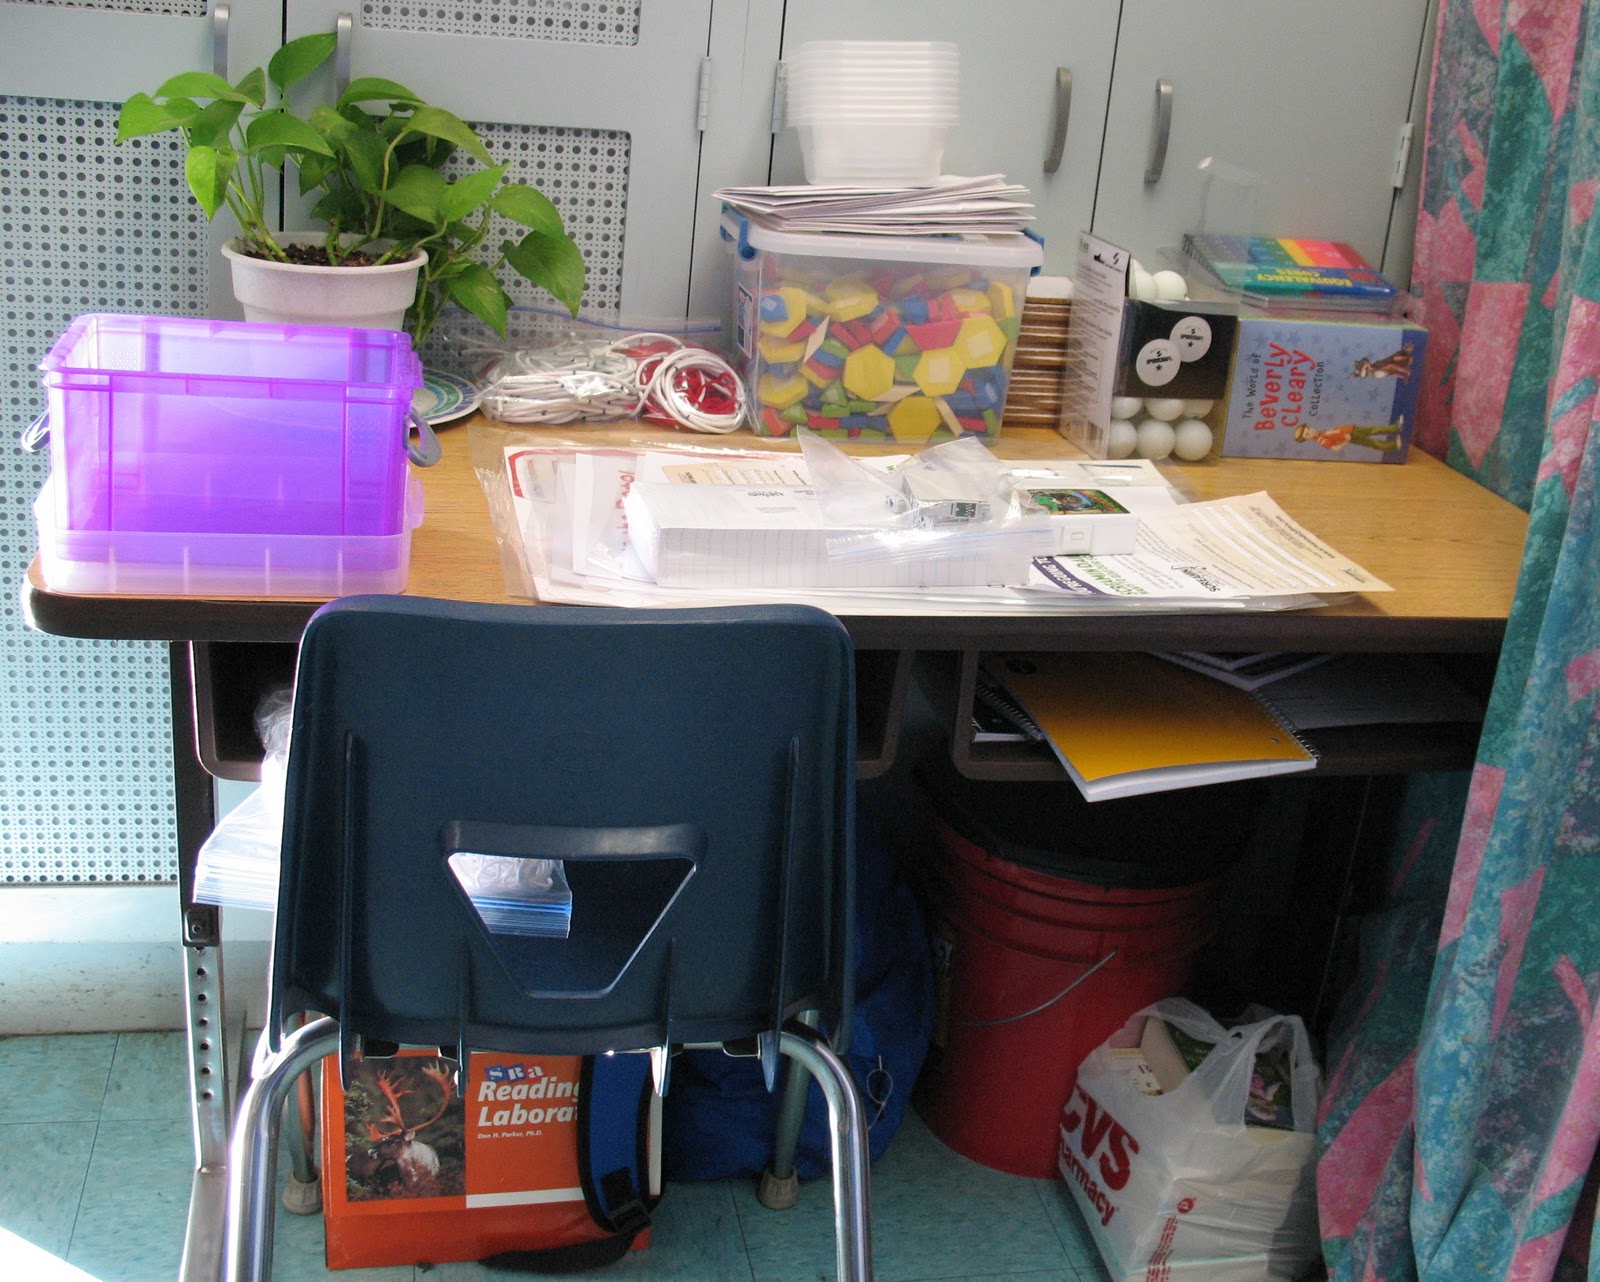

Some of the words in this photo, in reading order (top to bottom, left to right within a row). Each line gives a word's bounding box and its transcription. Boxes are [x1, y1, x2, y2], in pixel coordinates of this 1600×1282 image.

[1251, 352, 1262, 364] of
[1246, 367, 1259, 398] World
[1242, 401, 1255, 419] The
[478, 1103, 578, 1127] Labora
[1060, 1082, 1139, 1191] CVS
